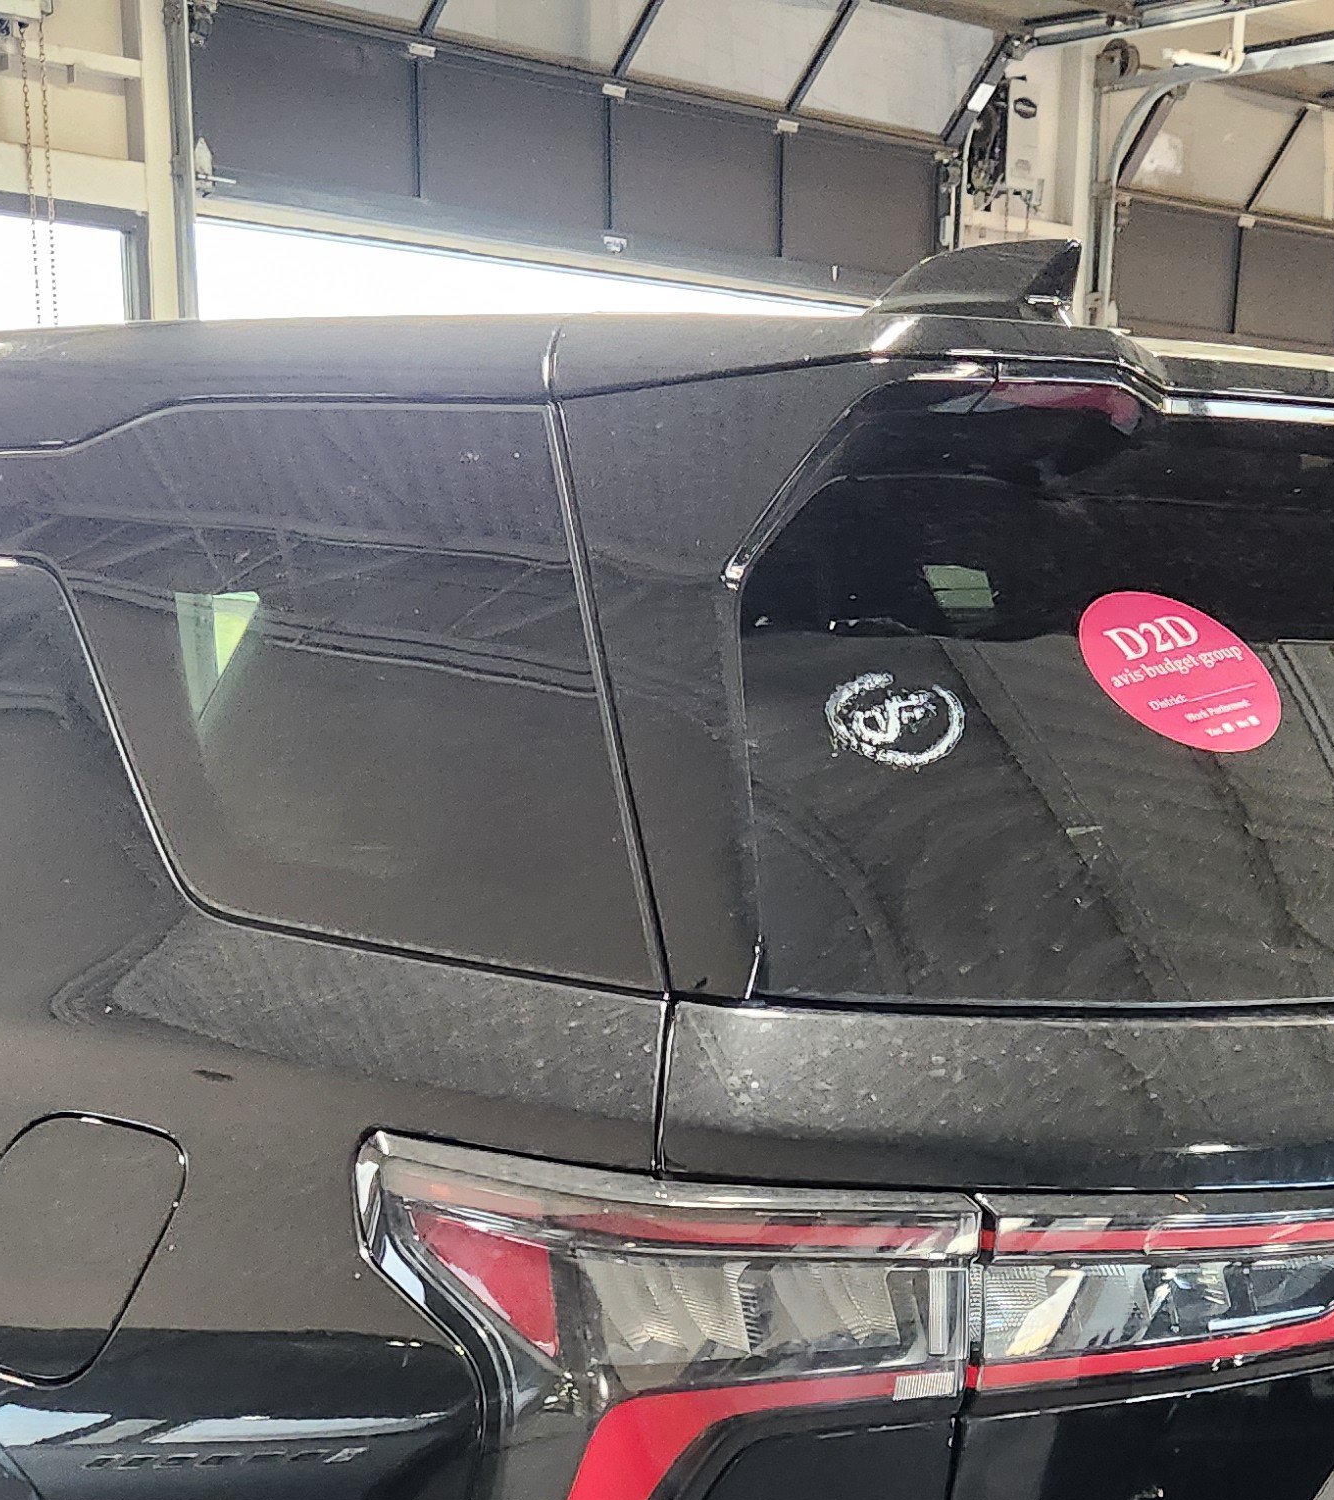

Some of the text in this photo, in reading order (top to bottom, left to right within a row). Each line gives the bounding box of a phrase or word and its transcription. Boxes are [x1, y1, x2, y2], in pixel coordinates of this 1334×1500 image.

[1102, 615, 1199, 661] D2D
[1110, 645, 1244, 689] avis budget group
